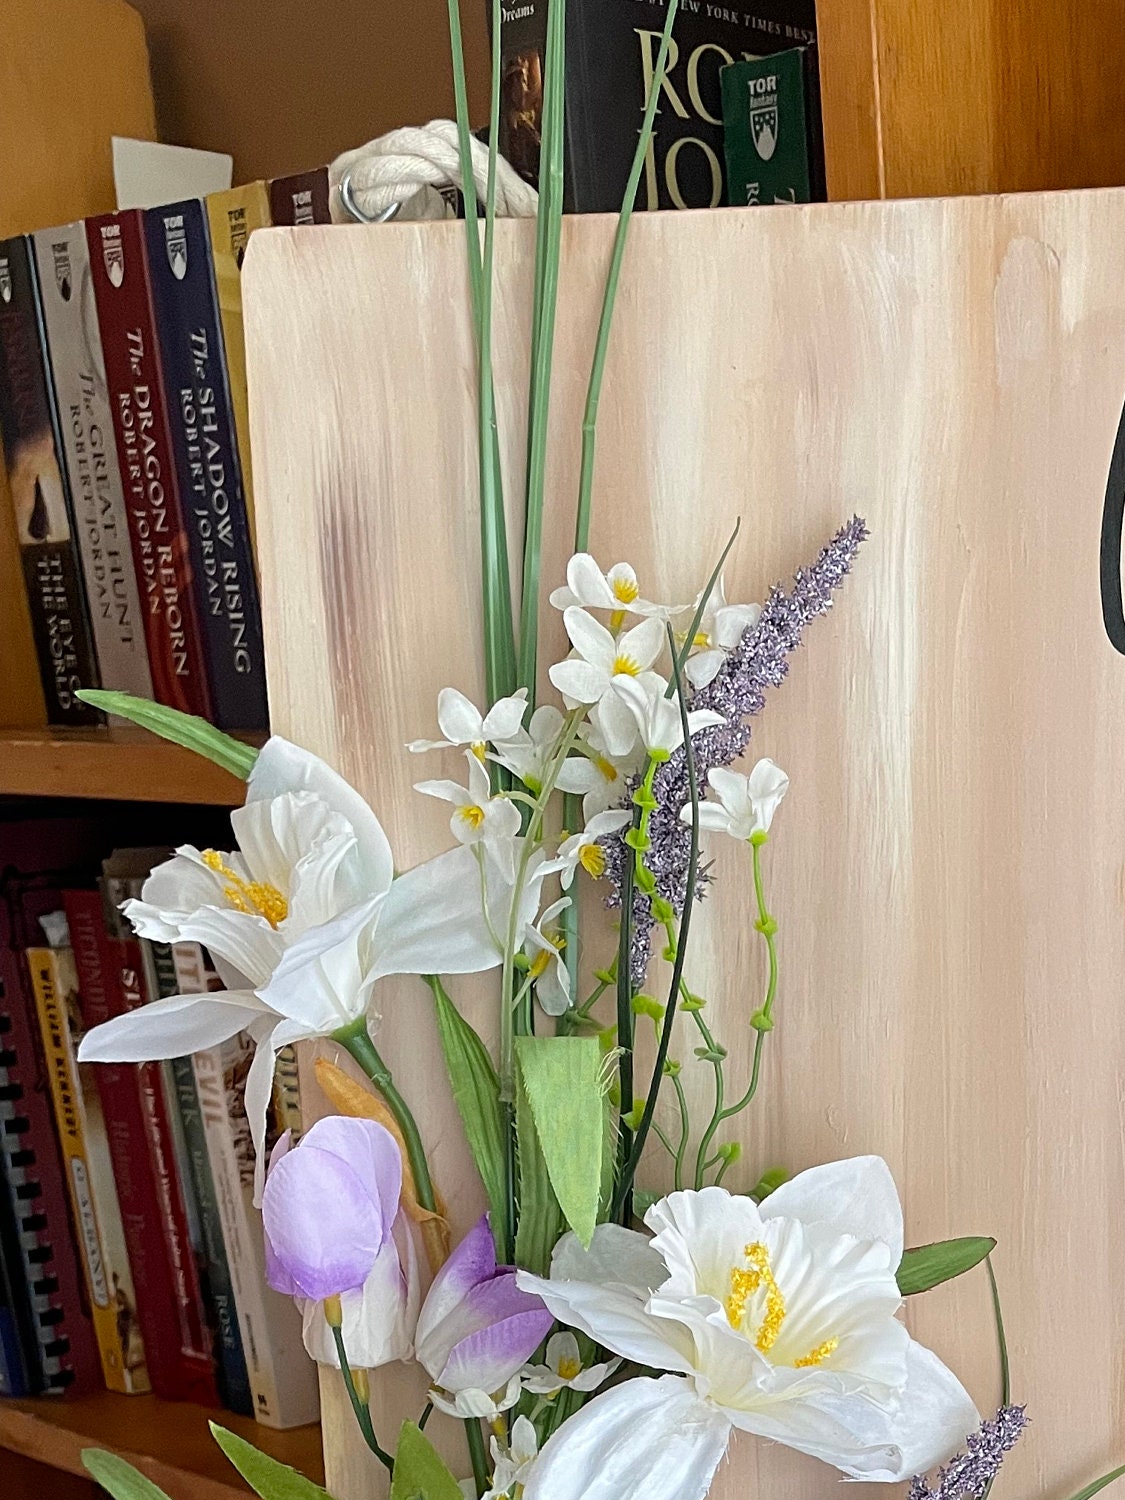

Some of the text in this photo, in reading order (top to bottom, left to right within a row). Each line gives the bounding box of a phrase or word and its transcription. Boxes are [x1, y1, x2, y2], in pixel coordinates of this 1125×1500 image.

[706, 4, 739, 24] YORK
[743, 13, 781, 36] TIMES
[747, 75, 777, 95] TOR
[89, 423, 119, 539] GREAT
[118, 392, 162, 615] ROBERT JORDAN
[126, 327, 190, 676] The DRAGON REBORN
[180, 388, 223, 616] ROBERT JORDAN
[190, 327, 251, 675] The SHADOW RISING
